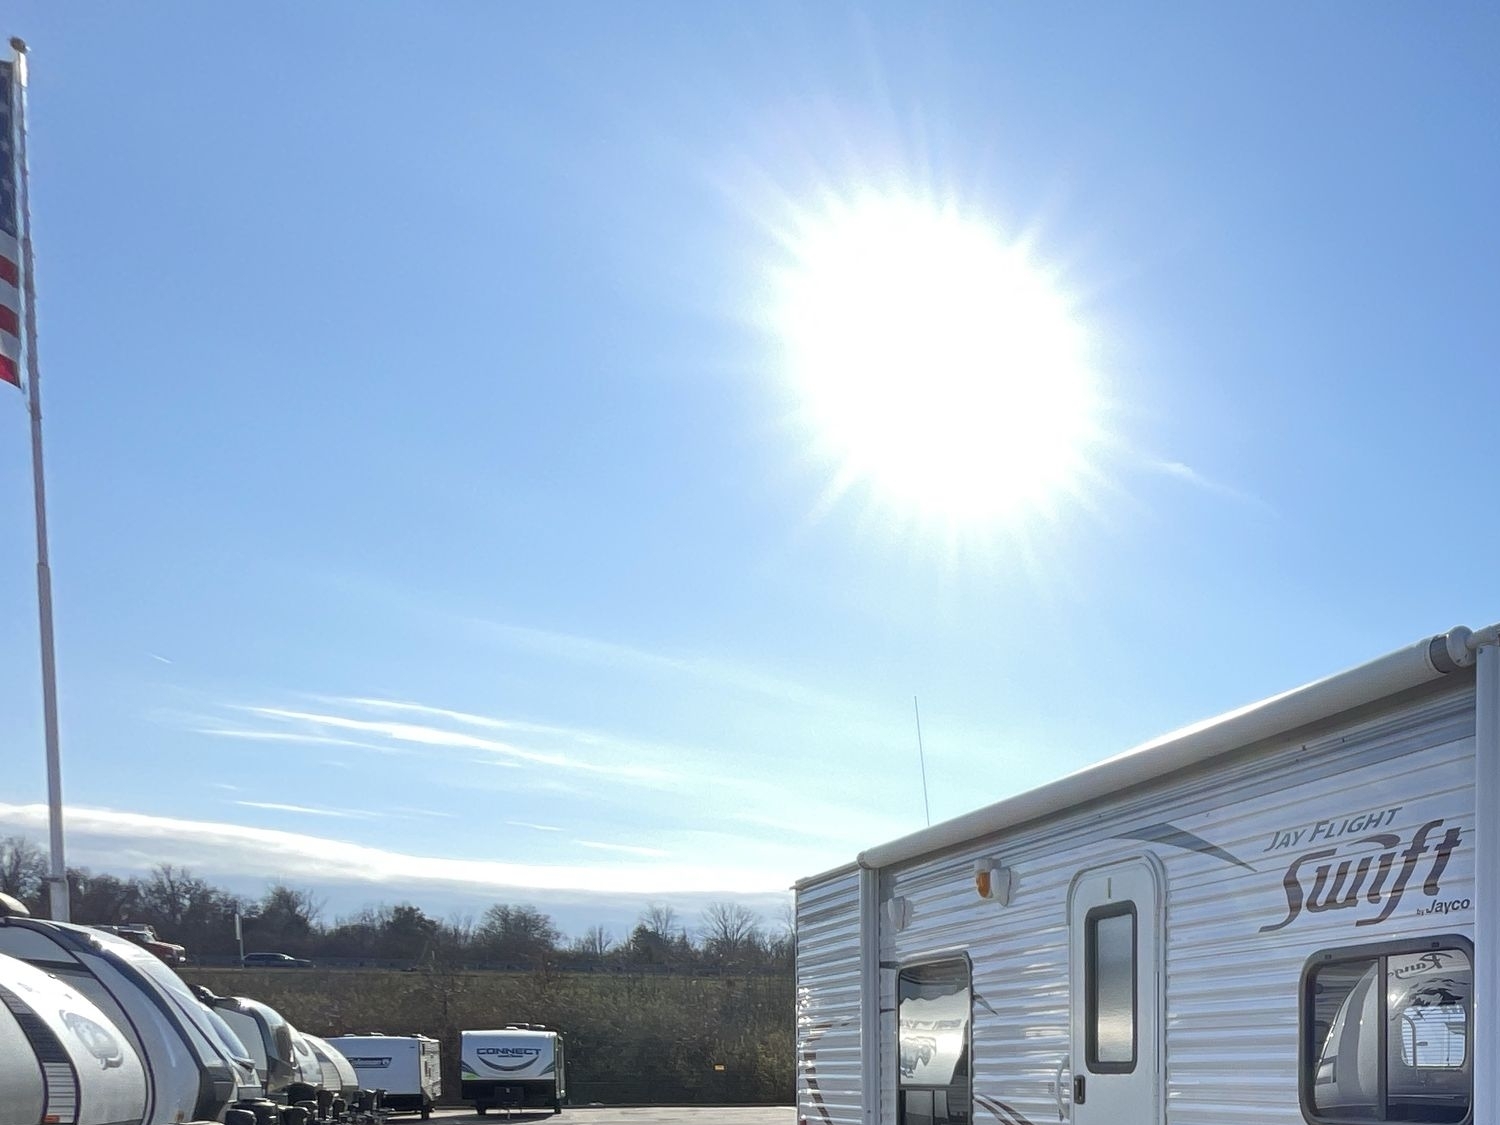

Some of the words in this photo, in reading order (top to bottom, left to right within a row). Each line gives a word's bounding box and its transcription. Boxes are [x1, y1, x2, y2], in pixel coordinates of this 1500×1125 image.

[1263, 829, 1310, 852] JAY
[1309, 807, 1403, 842] FLIGHT
[1258, 818, 1463, 933] Swift
[1425, 899, 1471, 915] Jayco
[476, 1047, 542, 1056] CONNECT
